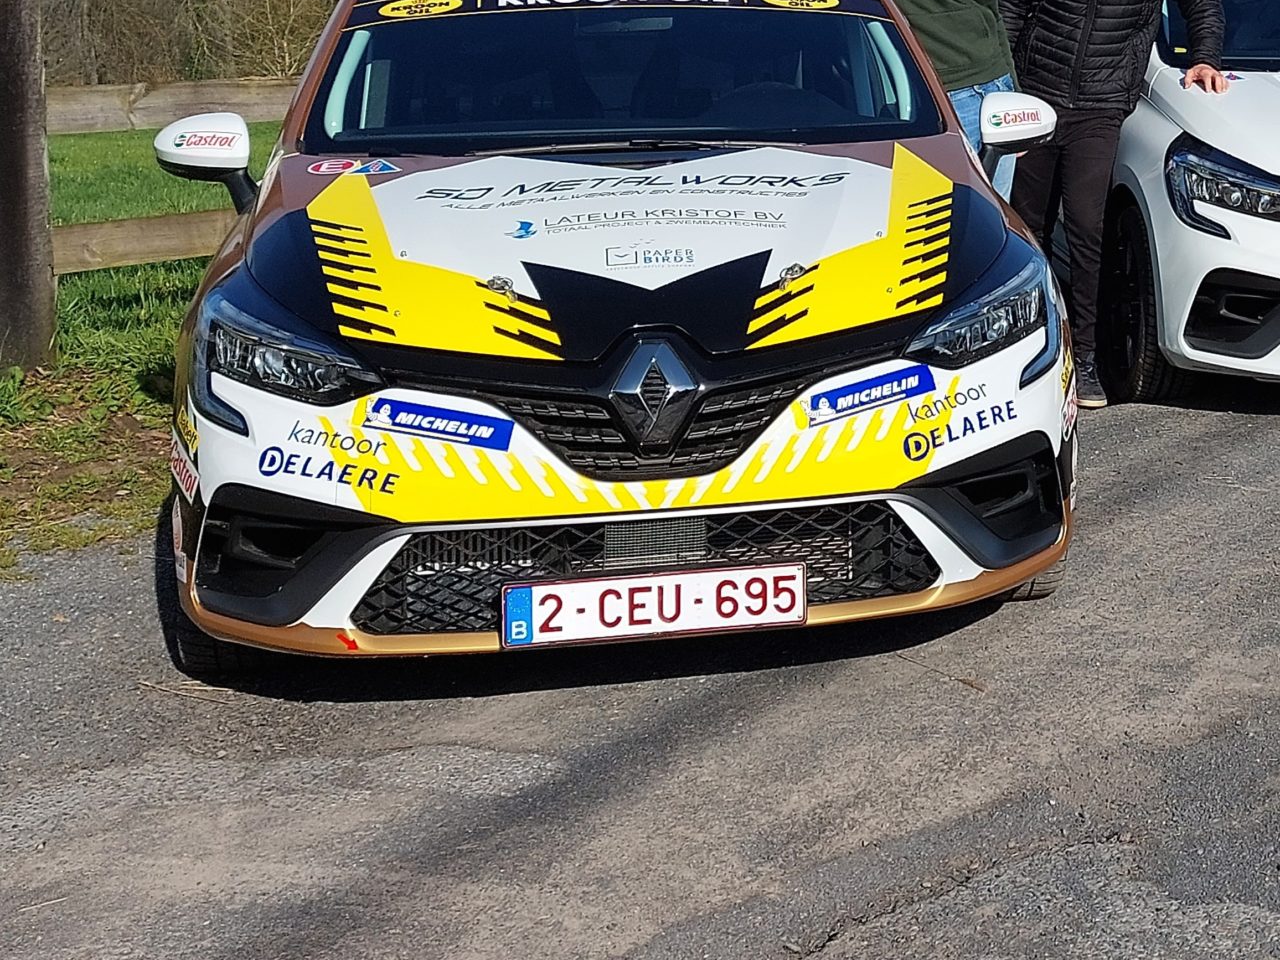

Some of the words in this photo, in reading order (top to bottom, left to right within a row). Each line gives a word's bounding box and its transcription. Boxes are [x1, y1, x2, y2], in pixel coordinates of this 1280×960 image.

[390, 1, 450, 13] KROON
[405, 7, 433, 16] OIL
[1003, 110, 1041, 125] Castrol
[185, 133, 236, 148] Castrol
[318, 161, 348, 172] E
[440, 202, 495, 210] ALLE
[495, 190, 648, 209] METAALWERKEN
[678, 188, 810, 197] CONSTRUCTIES
[544, 210, 638, 227] LATEUR
[645, 208, 747, 219] KRISTOF
[754, 211, 784, 221] BV
[545, 224, 592, 235] TOTAAL
[594, 220, 650, 229] PROJECT
[665, 220, 788, 229] ZWEMBADTECHNIEK
[643, 248, 694, 257] PAPER
[643, 256, 695, 264] BIRDS
[836, 374, 919, 414] MICHELIN
[907, 382, 987, 425] kantoor
[394, 411, 495, 439] MICHELIN
[903, 400, 1018, 462] DELAERE
[287, 419, 387, 458] kantoor
[258, 446, 401, 495] DELAERE
[511, 620, 528, 640] B
